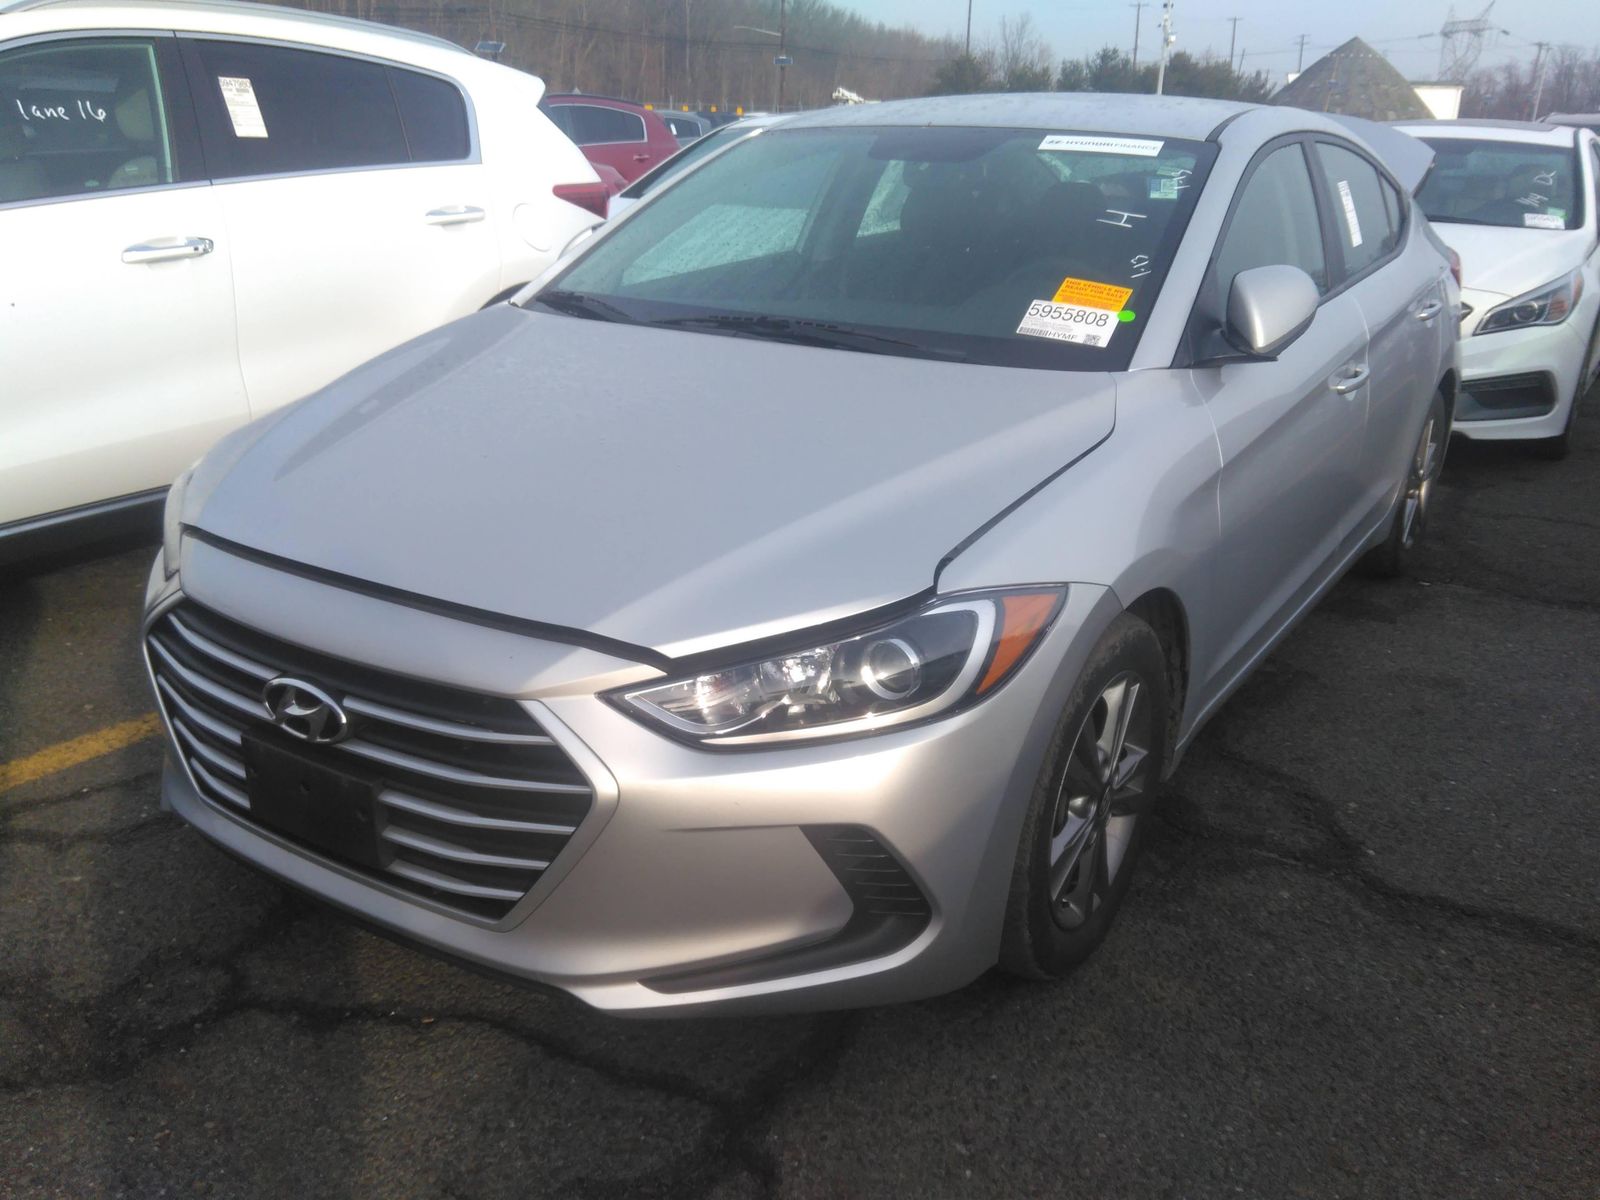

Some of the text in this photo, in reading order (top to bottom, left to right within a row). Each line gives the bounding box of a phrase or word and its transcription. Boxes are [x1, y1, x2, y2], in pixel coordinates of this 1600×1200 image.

[16, 99, 106, 122] lane 16
[1028, 303, 1109, 327] 5955808
